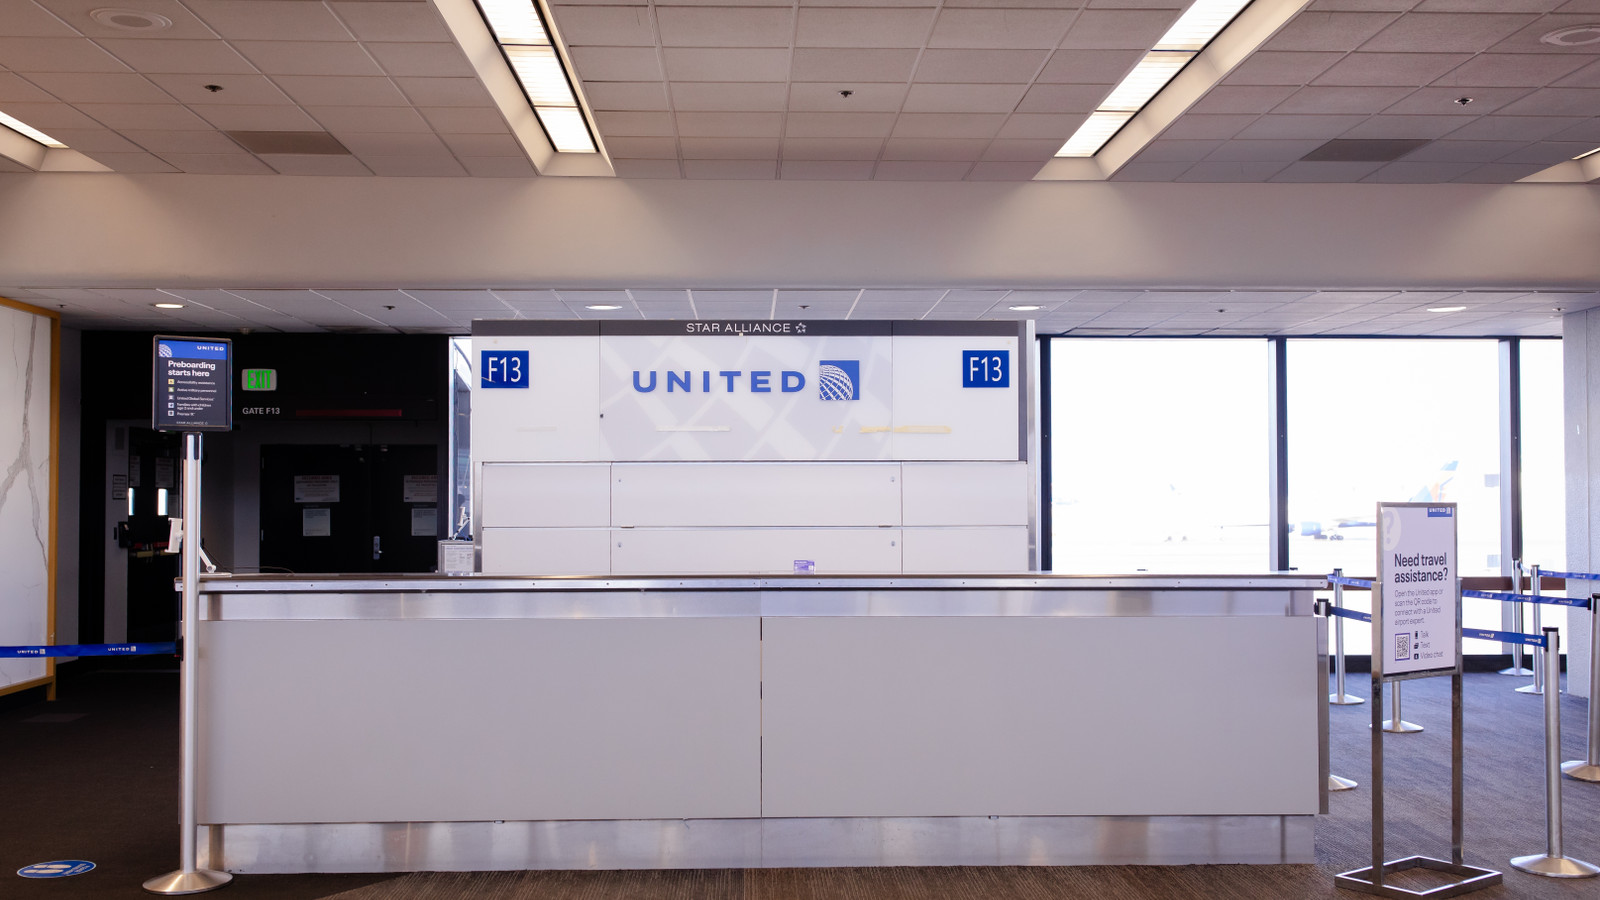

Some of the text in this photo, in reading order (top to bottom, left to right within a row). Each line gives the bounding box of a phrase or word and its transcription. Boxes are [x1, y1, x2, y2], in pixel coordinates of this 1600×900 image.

[686, 323, 791, 333] STAR ALLIANCE
[168, 360, 216, 371] Preboarding
[488, 356, 521, 382] F13
[970, 356, 1003, 382] F13
[247, 370, 272, 389] EXIT
[633, 370, 806, 393] UNITED
[242, 407, 281, 415] GATE F13
[1394, 552, 1447, 567] Need travel
[1394, 567, 1448, 583] assistance?
[1394, 590, 1407, 598] Open
[1407, 589, 1415, 597] the
[1415, 589, 1430, 597] United
[1430, 589, 1438, 597] app
[1414, 597, 1421, 606] QR
[1394, 609, 1413, 617] connect
[1394, 618, 1410, 627] airport
